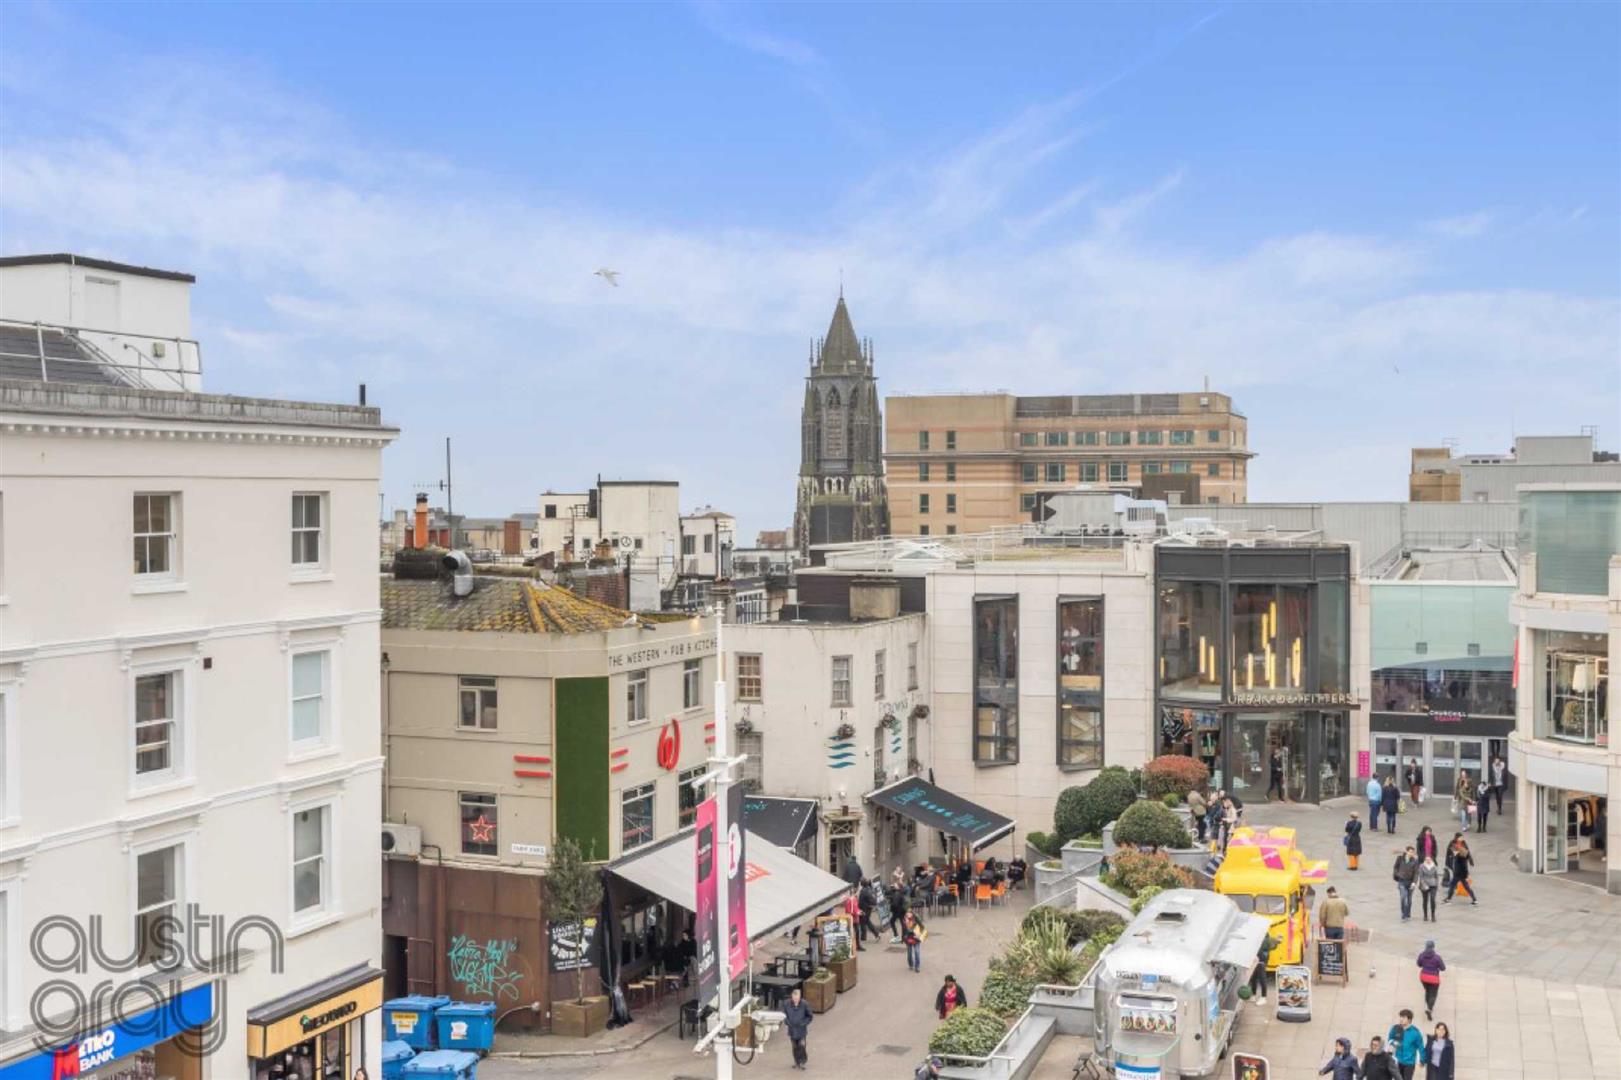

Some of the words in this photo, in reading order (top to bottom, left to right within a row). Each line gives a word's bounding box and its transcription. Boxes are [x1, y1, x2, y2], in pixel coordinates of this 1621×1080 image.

[608, 656, 623, 667] THE
[627, 649, 660, 664] WESTERN
[670, 644, 684, 656] PUB
[694, 637, 718, 651] KITCHE
[1228, 693, 1270, 705] URBAN
[1276, 692, 1353, 705] OUTFITTERS
[79, 1047, 115, 1072] BANK
